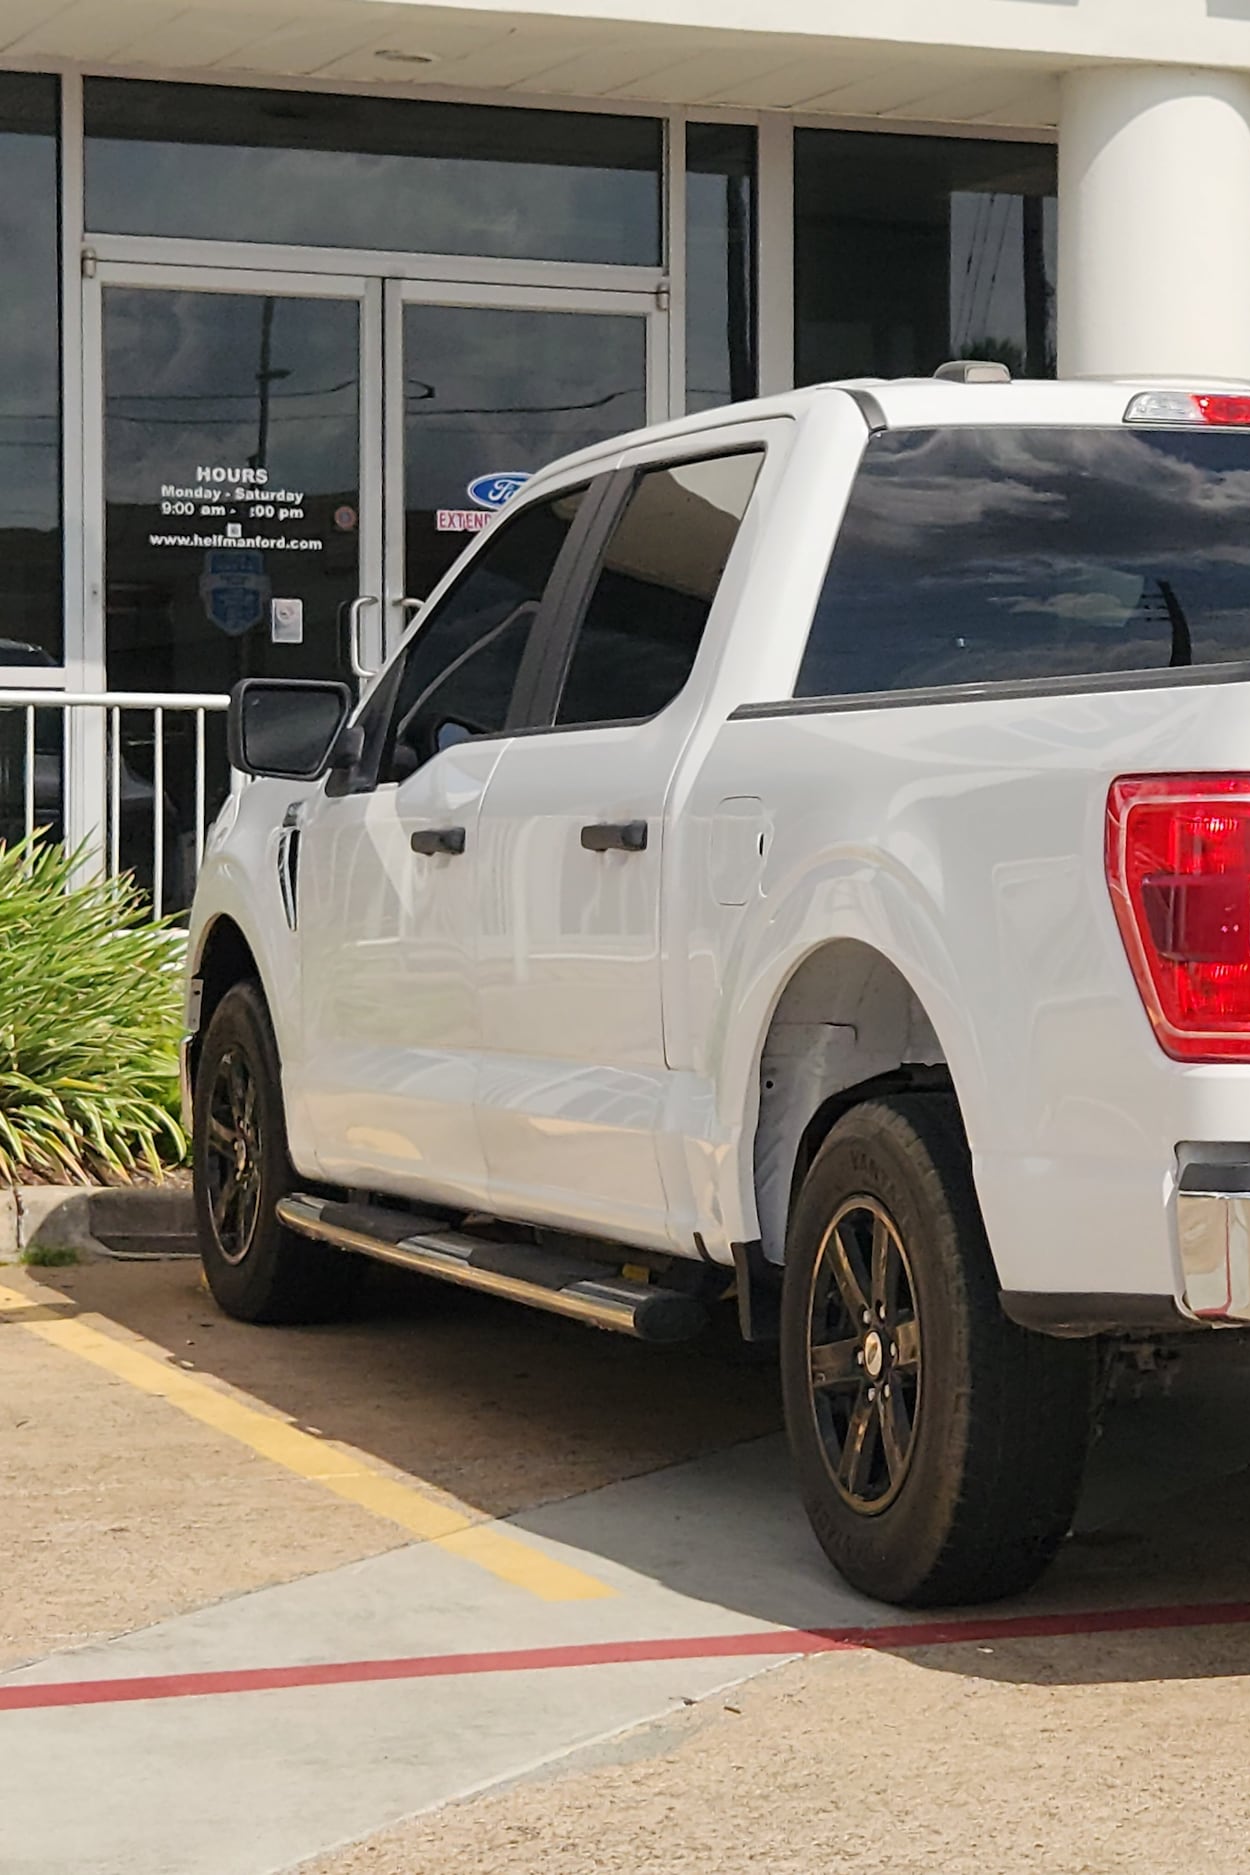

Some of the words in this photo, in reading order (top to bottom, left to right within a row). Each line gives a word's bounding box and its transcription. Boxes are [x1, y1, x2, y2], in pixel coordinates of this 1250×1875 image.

[196, 466, 269, 485] HOURS
[161, 484, 221, 502] Monday
[234, 487, 304, 504] Saturday
[161, 502, 195, 516] 9:00
[200, 505, 226, 516] am
[278, 508, 304, 521] pm
[149, 534, 323, 551] www.helfmanford.com
